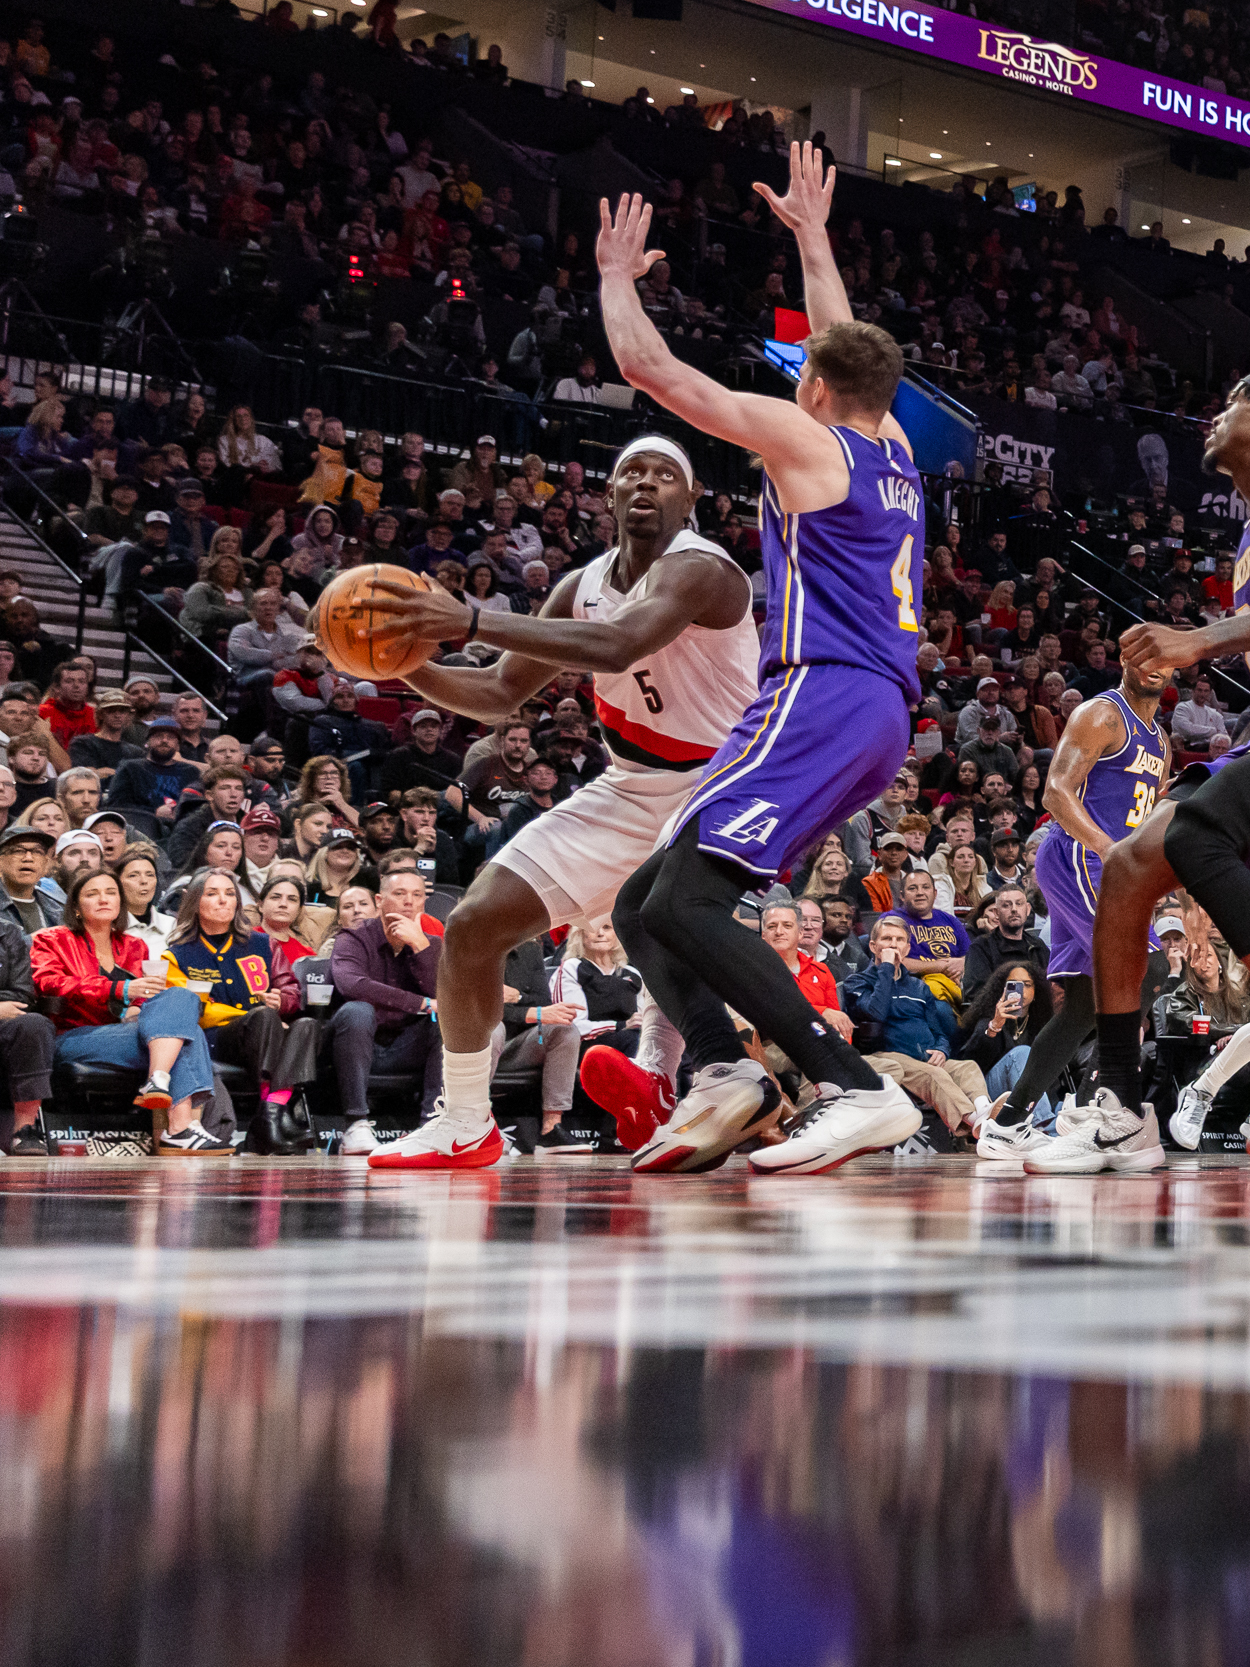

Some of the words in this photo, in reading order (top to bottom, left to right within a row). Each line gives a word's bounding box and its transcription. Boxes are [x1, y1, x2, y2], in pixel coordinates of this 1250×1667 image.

[789, 0, 934, 42] LGENCE
[978, 28, 1098, 90] LEGENDS
[1002, 67, 1036, 85] CASINO
[1046, 80, 1073, 96] HOTEL
[1143, 81, 1192, 118] FUN
[1199, 98, 1218, 126] IS
[877, 476, 920, 522] KNECHT
[890, 533, 919, 632] 4
[632, 669, 664, 714] 5
[1124, 744, 1165, 782] LAKER
[709, 797, 780, 846] LA
[1125, 780, 1156, 828] 36
[909, 925, 957, 946] LAKERS
[235, 954, 270, 995] B
[49, 1130, 90, 1140] SPIRIT
[1201, 1131, 1225, 1140] SPIRIT
